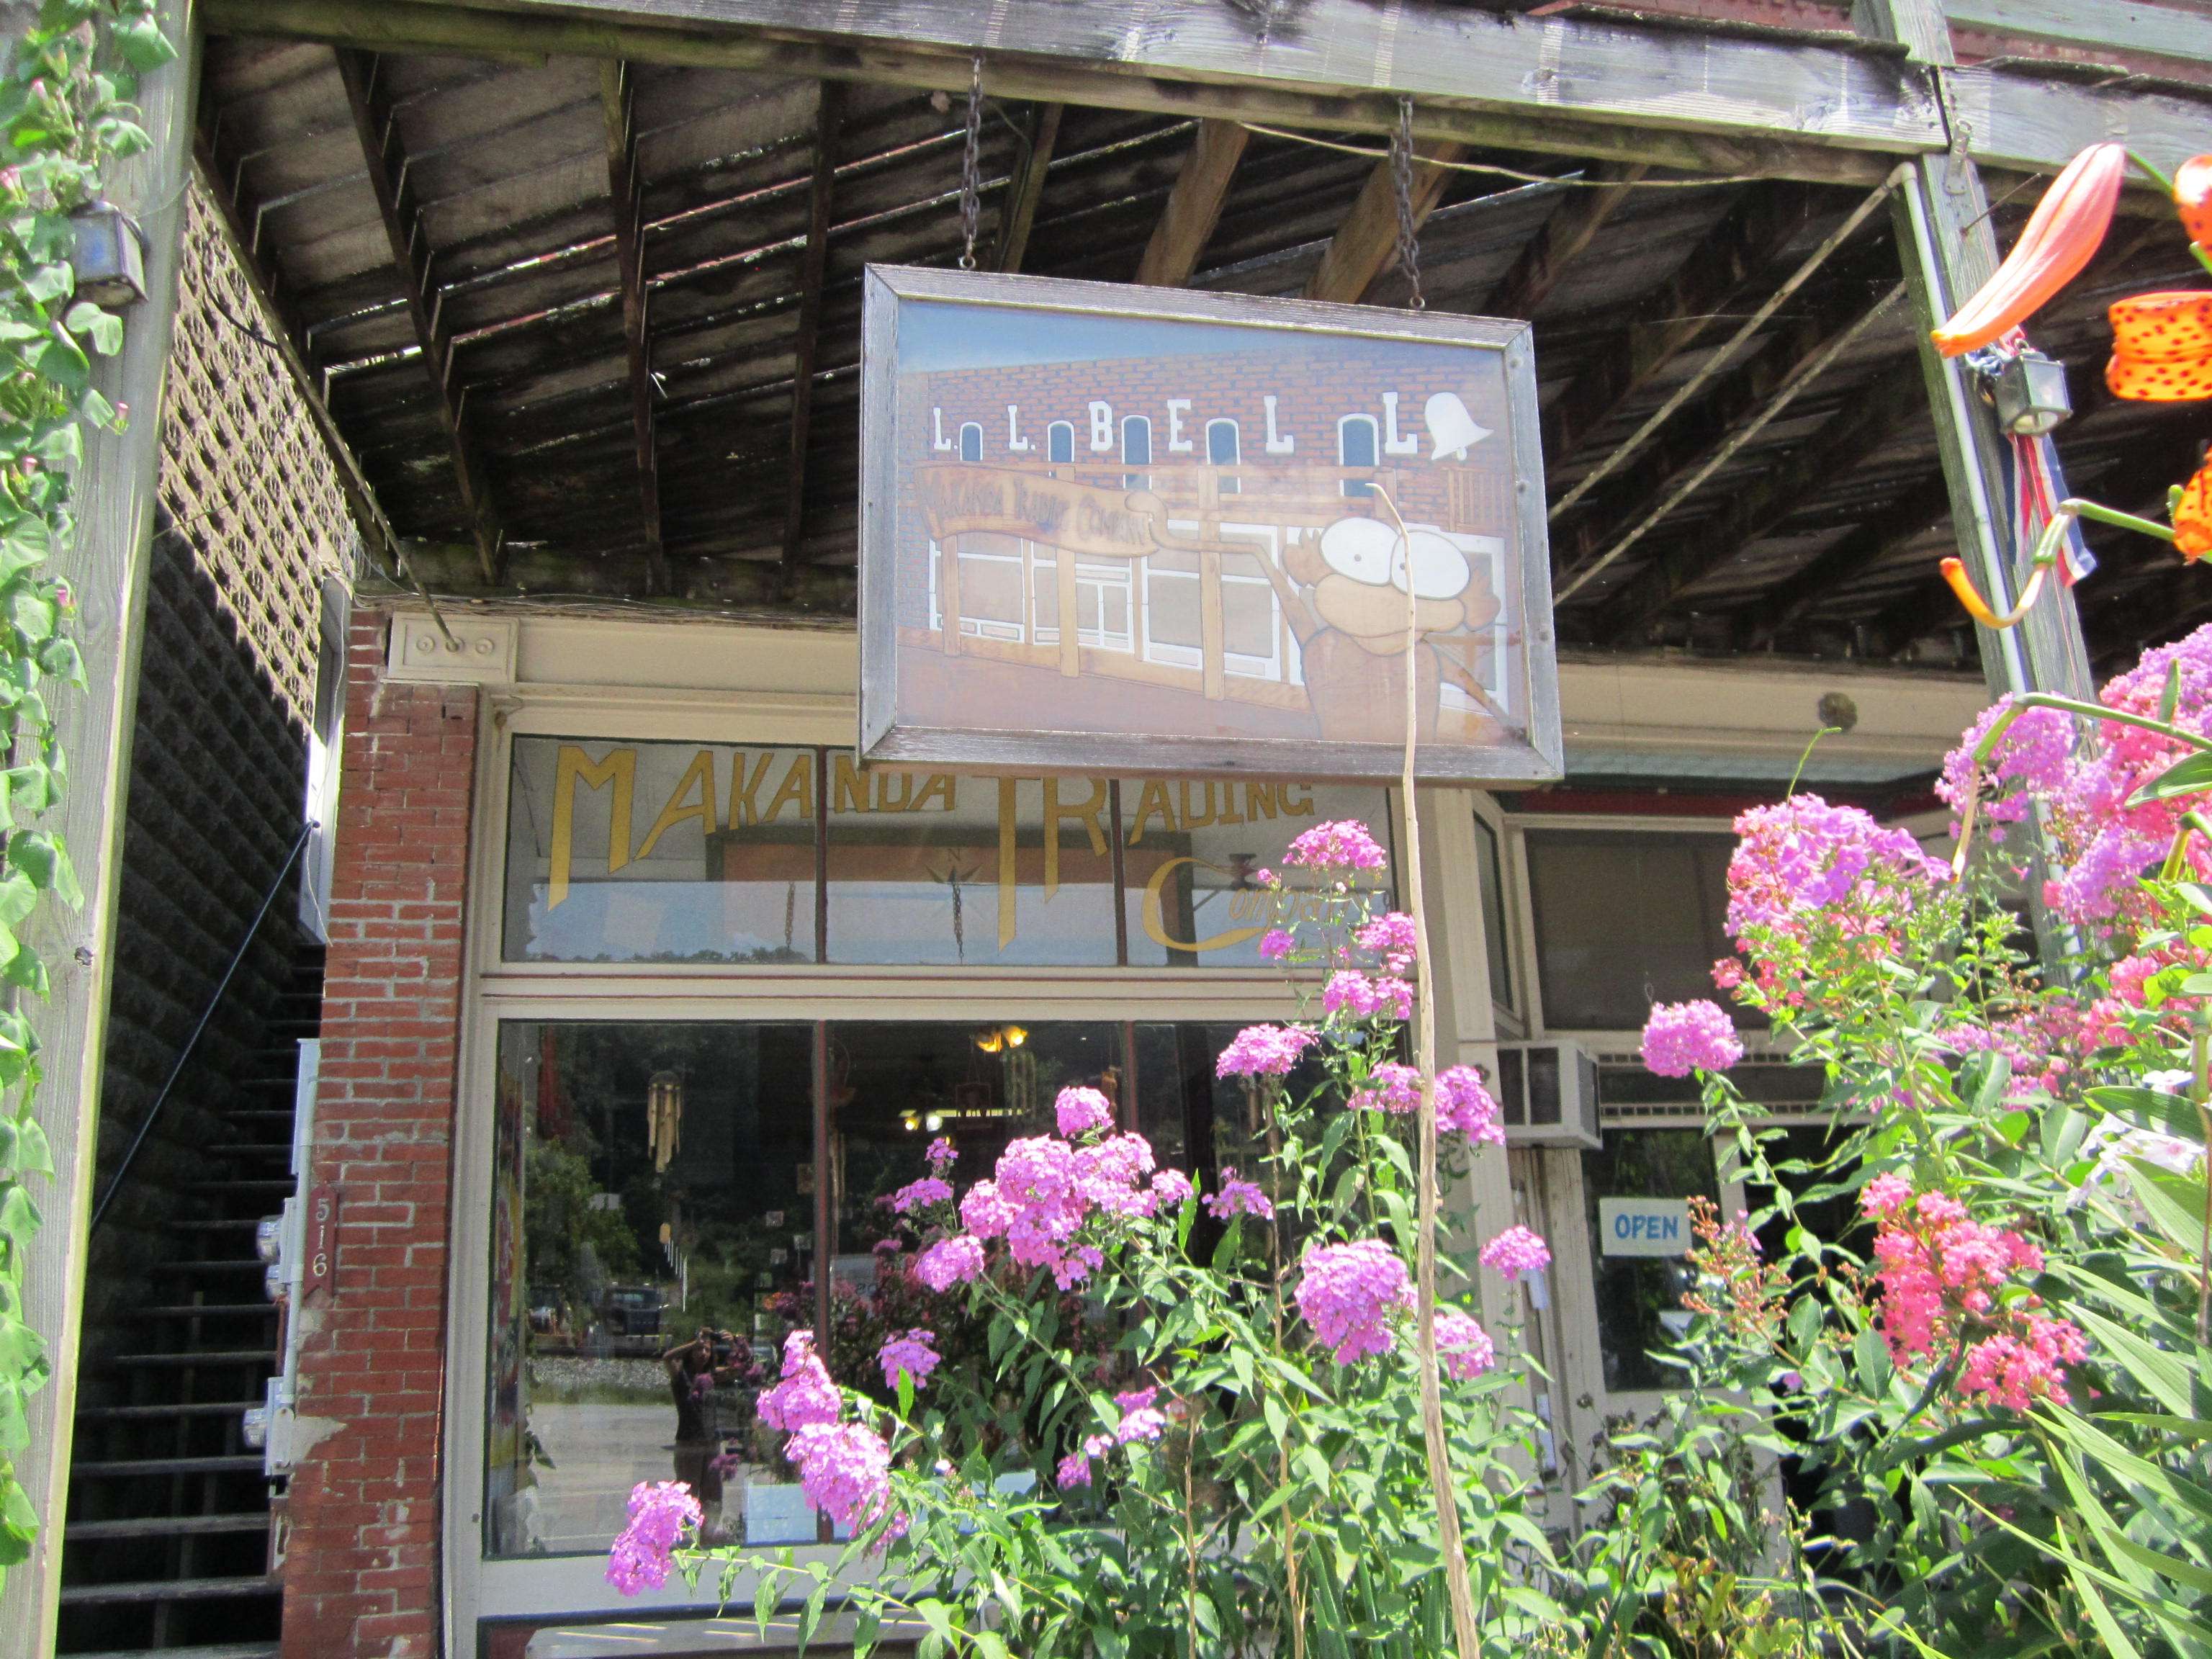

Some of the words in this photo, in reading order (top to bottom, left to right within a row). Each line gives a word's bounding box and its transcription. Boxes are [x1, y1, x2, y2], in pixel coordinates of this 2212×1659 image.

[547, 745, 956, 912] MAKANDA
[313, 1198, 331, 1277] 516
[1615, 1213, 1678, 1239] OPEN
